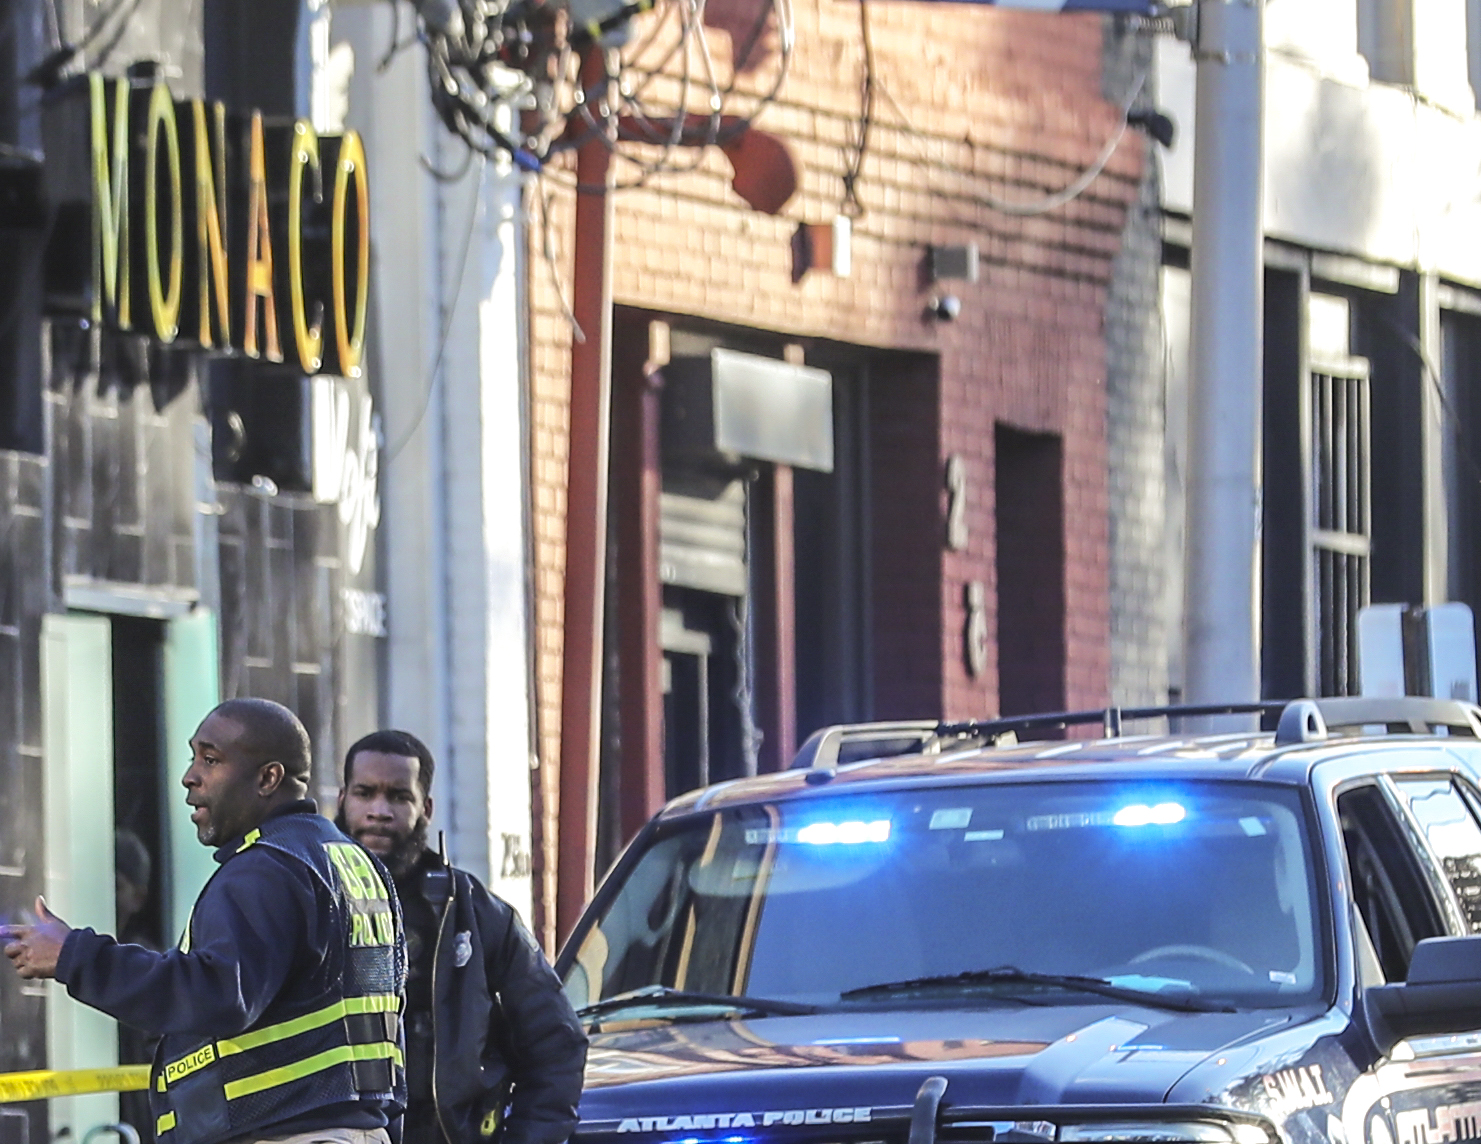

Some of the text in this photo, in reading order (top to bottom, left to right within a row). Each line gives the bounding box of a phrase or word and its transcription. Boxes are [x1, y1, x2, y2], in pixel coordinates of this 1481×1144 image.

[89, 70, 369, 378] MONACO
[351, 911, 395, 946] POLIC
[167, 1047, 212, 1078] POLICE
[616, 1106, 873, 1133] ATLANTA POLICE
